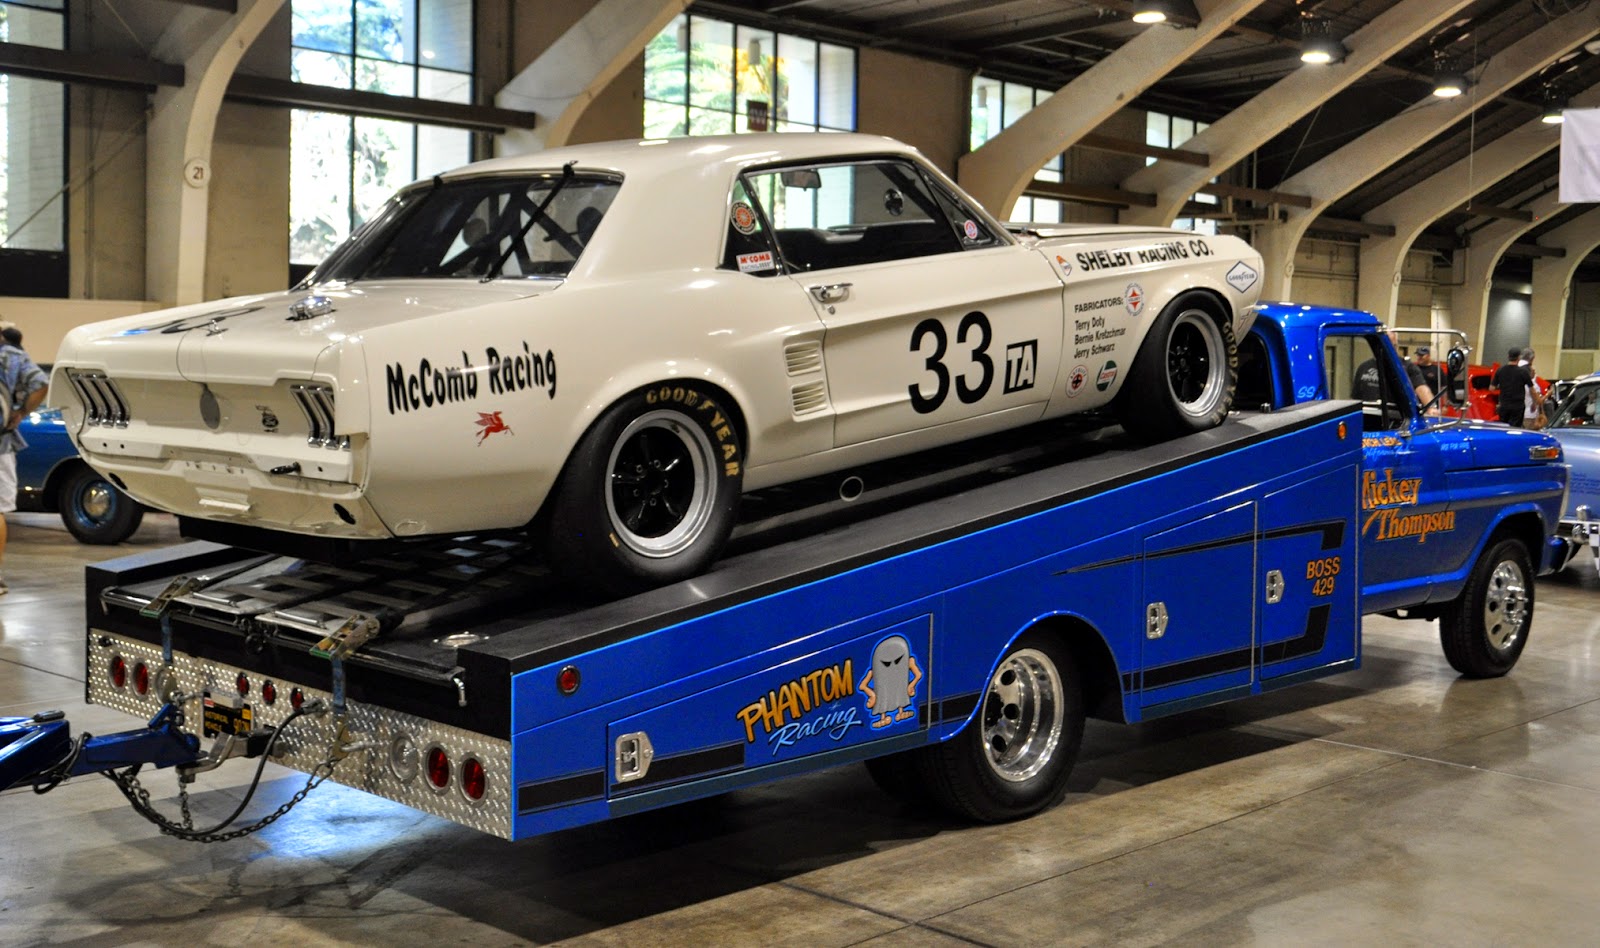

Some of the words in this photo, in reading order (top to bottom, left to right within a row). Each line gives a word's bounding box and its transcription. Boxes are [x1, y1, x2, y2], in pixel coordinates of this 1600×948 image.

[193, 166, 204, 180] 21
[1076, 249, 1136, 271] SHELBY
[1137, 242, 1189, 264] RACING
[1189, 239, 1215, 257] CO.
[1075, 297, 1124, 313] FABRICATORS:
[1075, 318, 1091, 331] Terry
[1091, 315, 1106, 328] Doty
[1074, 332, 1094, 345] Bernie
[1073, 347, 1090, 359] Jerry
[1091, 342, 1116, 356] Schwarz
[907, 310, 995, 415] 33
[1005, 342, 1036, 393] TA
[385, 350, 479, 415] McComb
[485, 340, 557, 401] Racing
[1362, 508, 1456, 543] Thompson
[1306, 556, 1341, 579] BOSS
[1312, 576, 1335, 596] 429
[736, 659, 853, 742] PHANTOM
[768, 703, 862, 756] Racing
